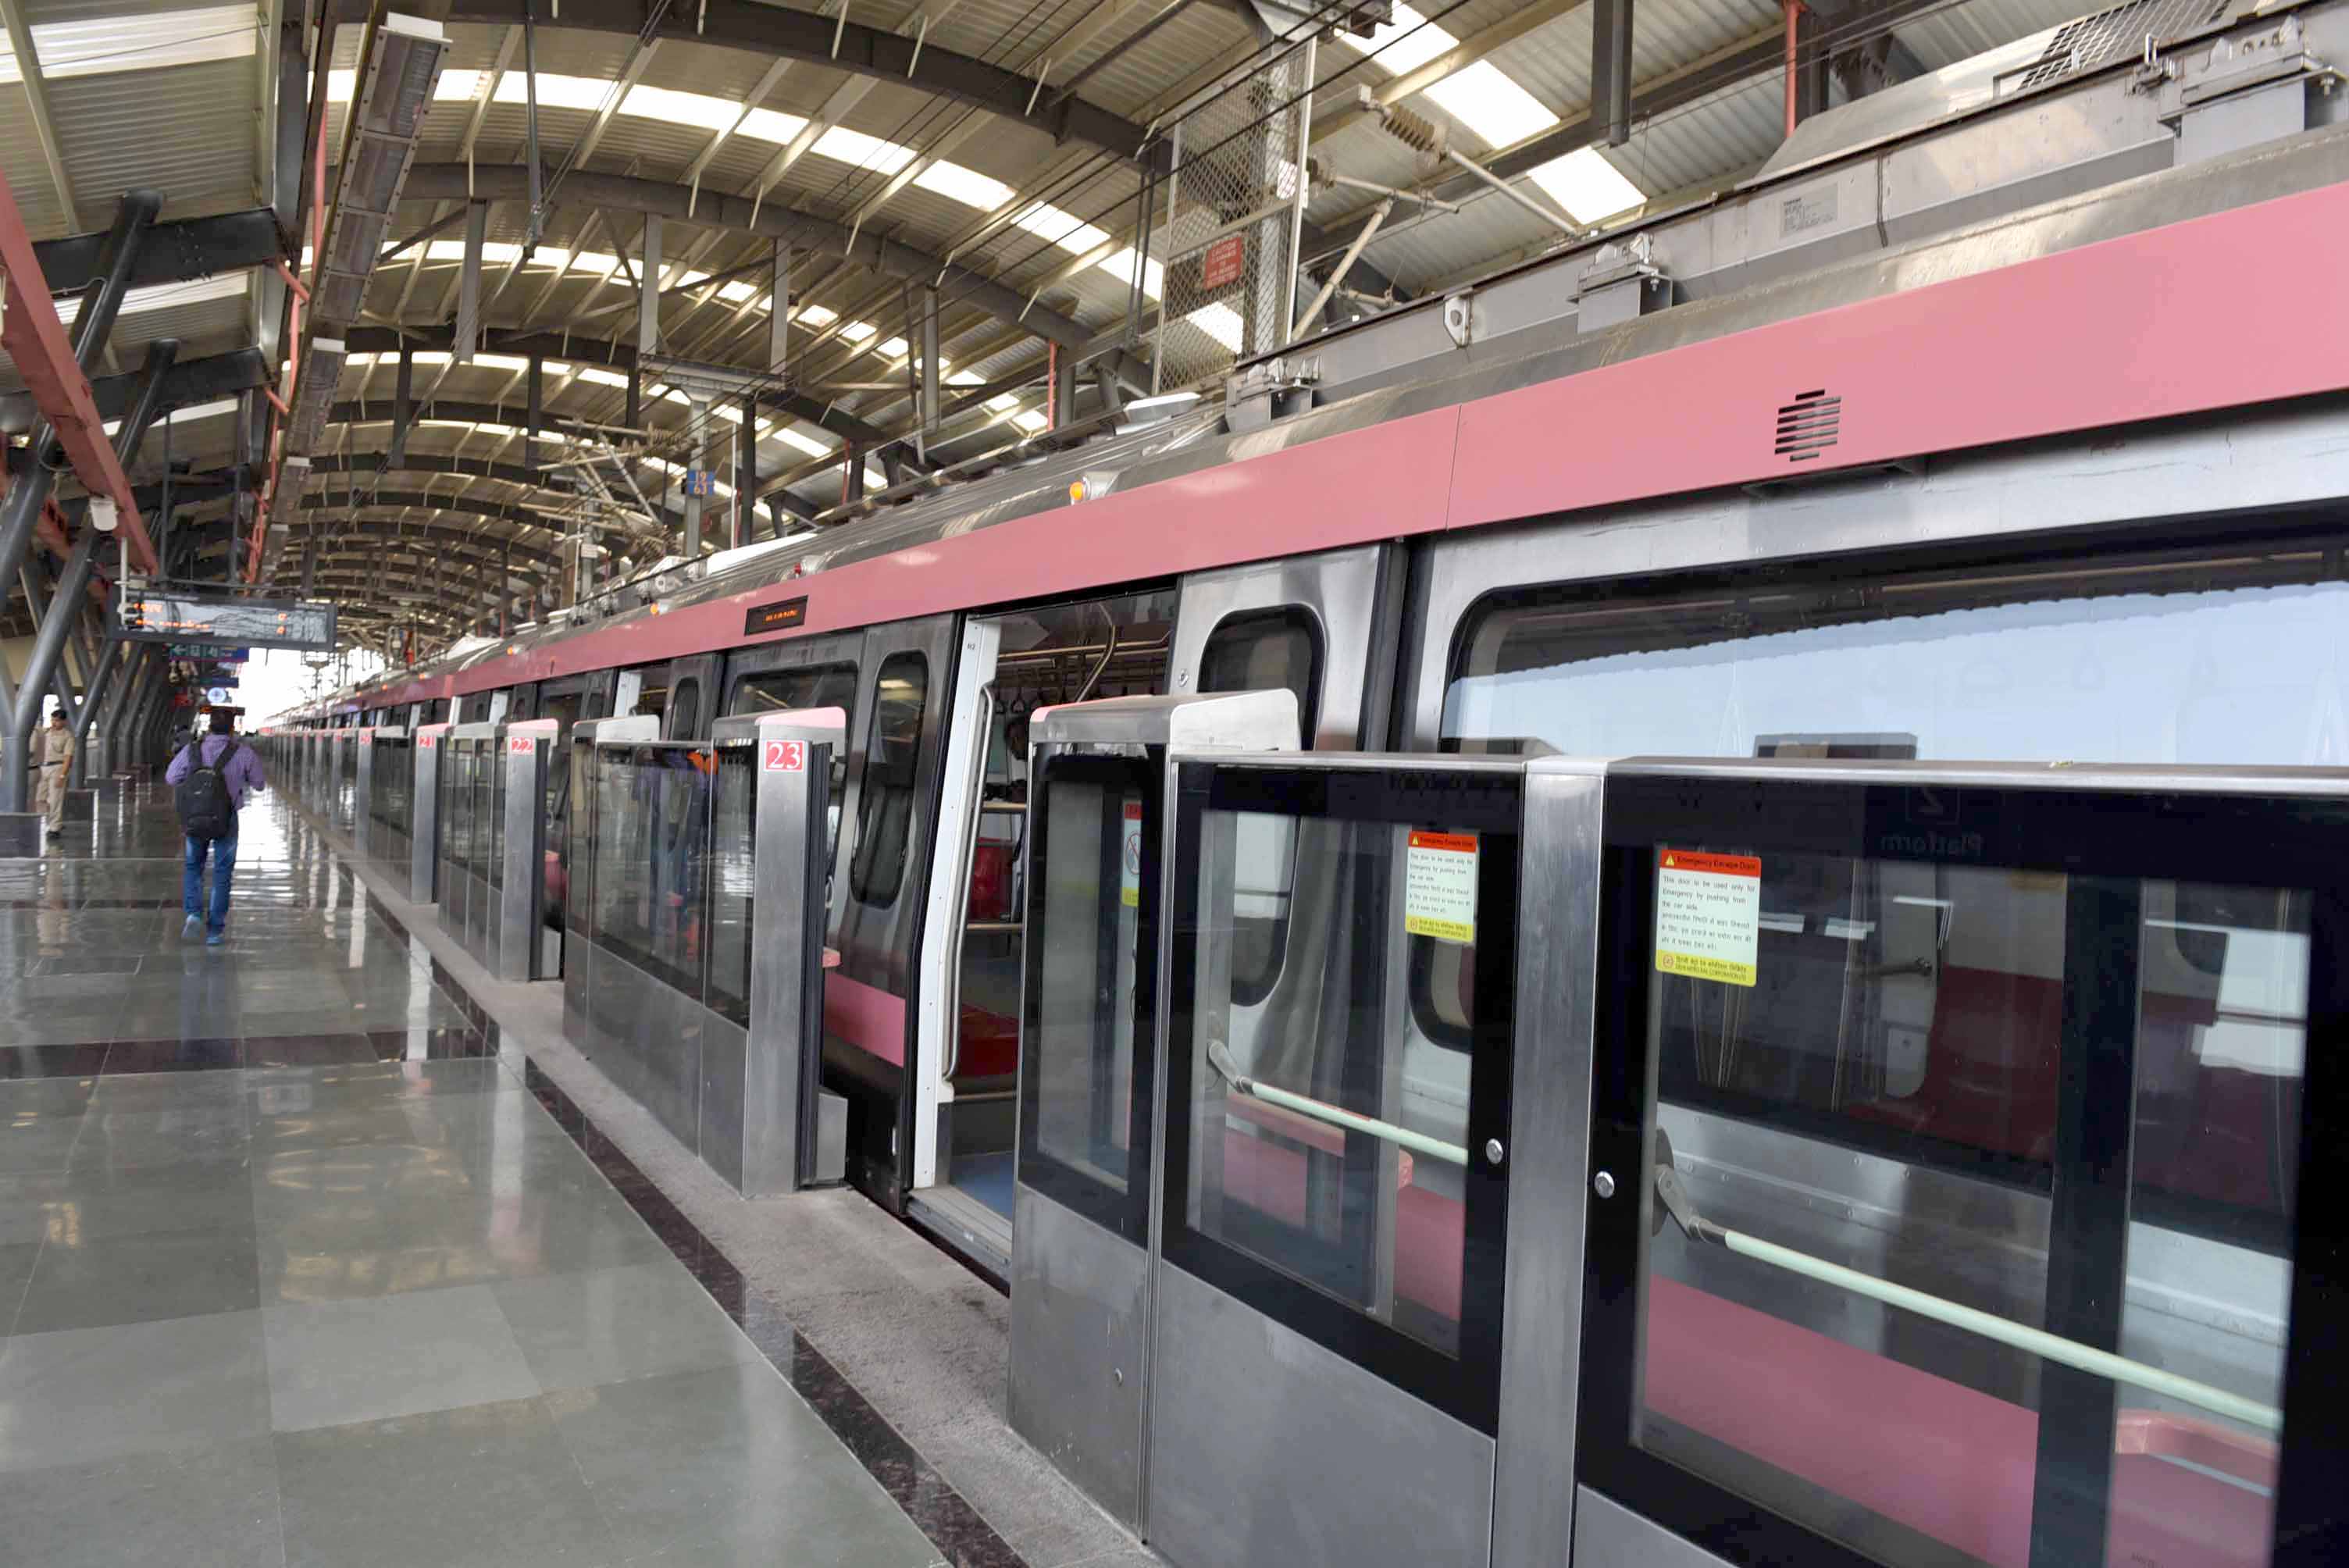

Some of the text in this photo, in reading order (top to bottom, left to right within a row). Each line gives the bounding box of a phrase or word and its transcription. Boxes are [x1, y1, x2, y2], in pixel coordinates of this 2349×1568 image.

[512, 738, 533, 754] 22
[768, 743, 802, 770] 23
[1678, 877, 1690, 886] door
[1714, 881, 1728, 889] used
[1731, 883, 1743, 893] only
[1663, 889, 1693, 900] Emergency
[1707, 894, 1730, 903] pushing
